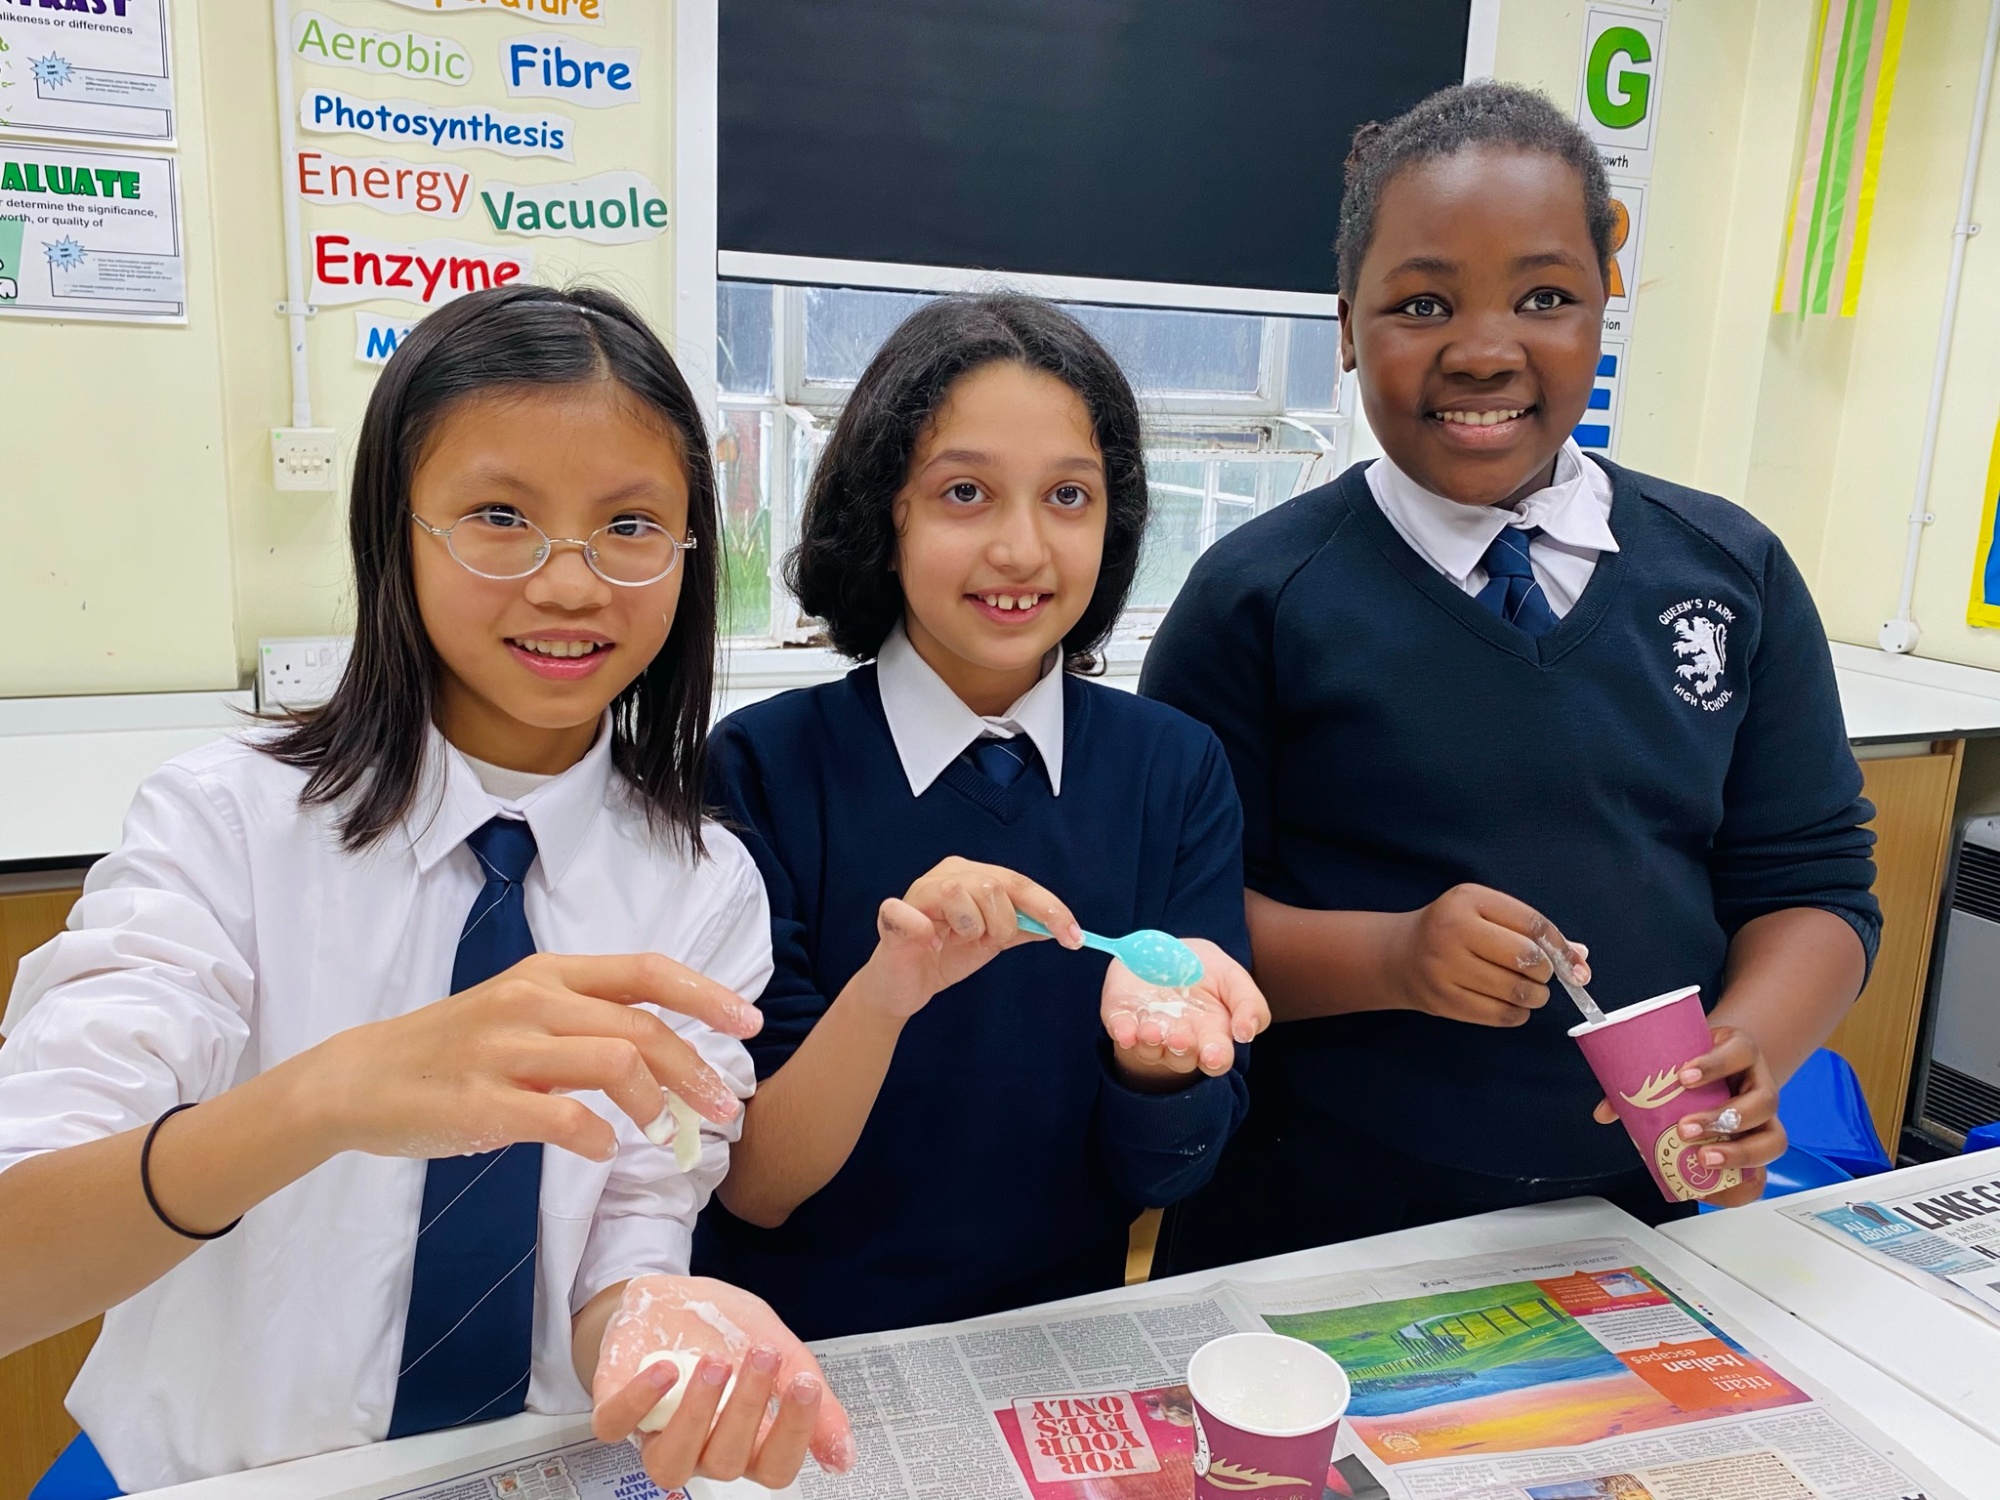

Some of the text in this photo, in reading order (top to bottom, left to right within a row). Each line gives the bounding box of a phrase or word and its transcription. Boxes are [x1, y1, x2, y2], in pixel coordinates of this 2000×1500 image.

[69, 20, 133, 35] differences
[298, 19, 465, 80] Aerobic
[510, 44, 632, 90] Fibre
[1587, 26, 1652, 130] G
[314, 95, 564, 149] Photosynthesis
[1601, 154, 1629, 169] owth
[1, 162, 141, 199] ALUATE
[298, 152, 469, 214] Energy
[6, 199, 64, 211] determine
[67, 203, 85, 213] the
[87, 204, 158, 219] significance,
[480, 187, 668, 230] Vacuole
[37, 217, 49, 225] or
[52, 217, 90, 229] quality
[92, 219, 104, 228] of
[316, 235, 521, 301] Enzyme
[367, 327, 410, 358] M
[1659, 599, 1736, 625] QUEEN'S PARK
[1673, 683, 1733, 712] HIGH SCHOOL
[1892, 1190, 2000, 1230] LAKE
[1842, 1220, 1870, 1234] ALL
[1859, 1223, 1912, 1243] ABOARD
[1630, 1349, 1697, 1365] escapes
[1661, 1353, 1745, 1373] Italian
[1708, 1373, 1742, 1384] travel
[1710, 1374, 1772, 1392] titan
[1031, 1396, 1124, 1420] ONLY
[1036, 1413, 1130, 1438] EYES
[1035, 1431, 1145, 1456] YOUR
[1056, 1450, 1136, 1475] FOR
[613, 1480, 657, 1499] EALTH
[619, 1471, 647, 1487] ORY
